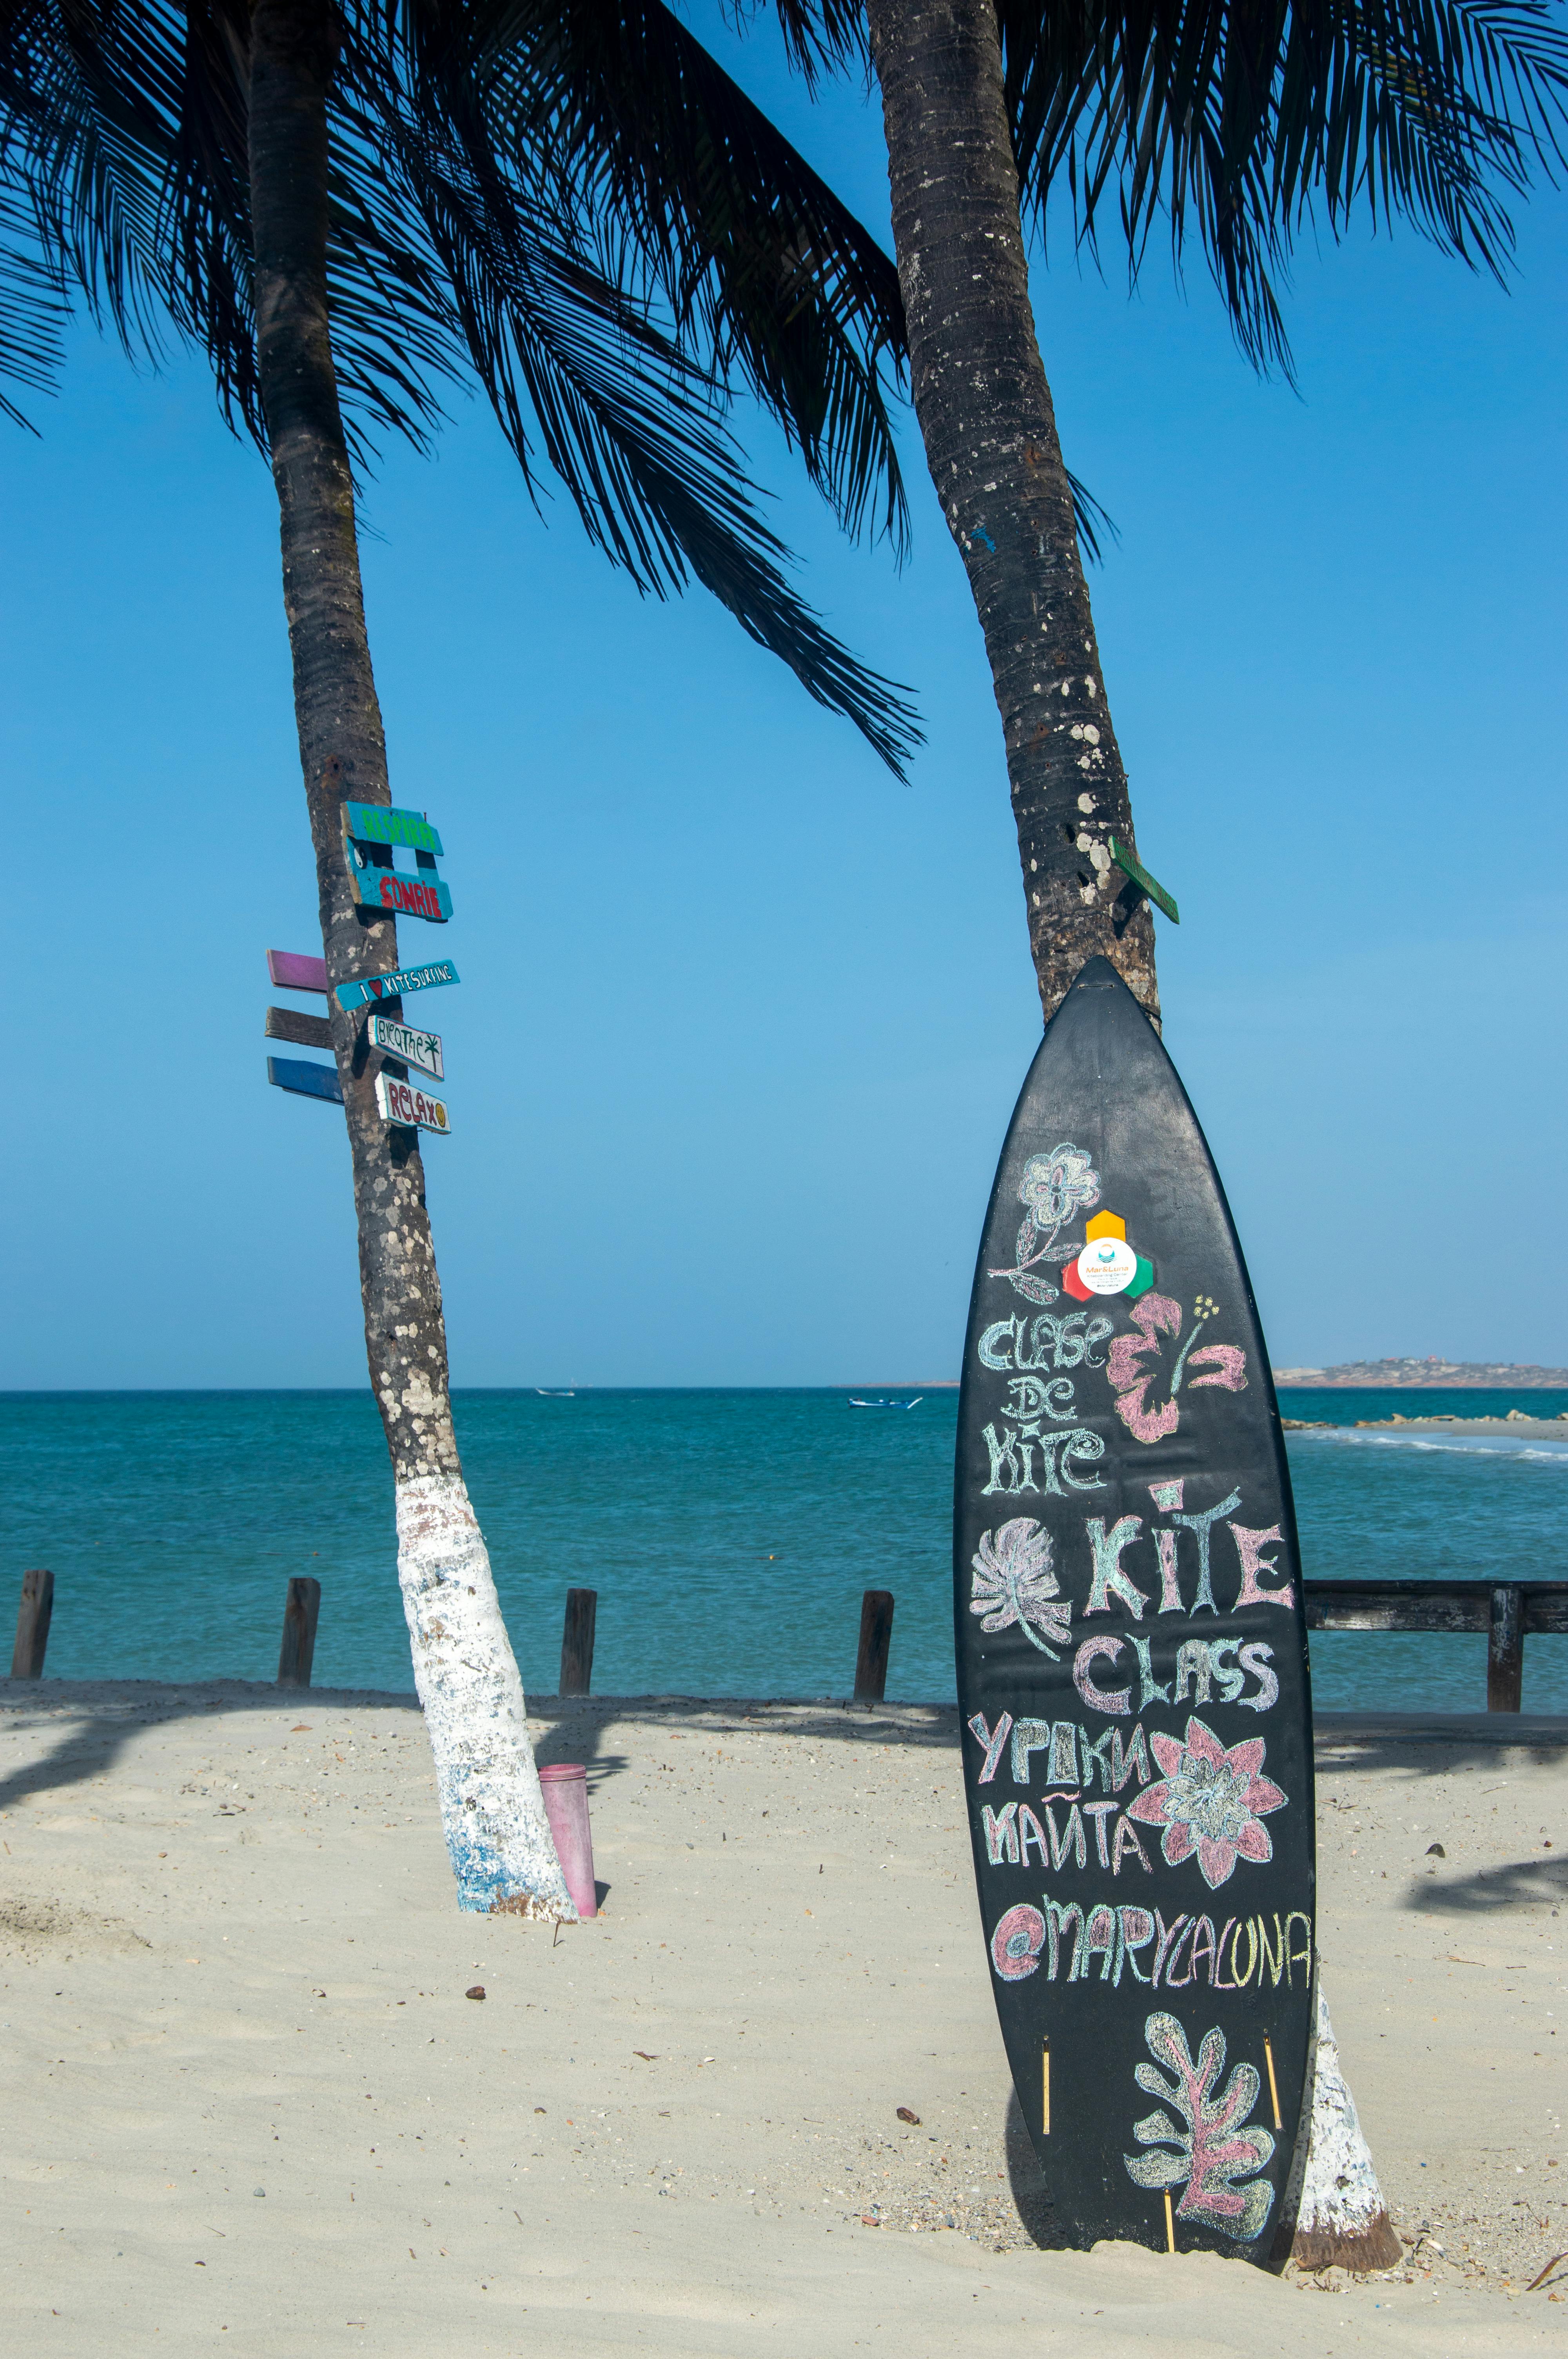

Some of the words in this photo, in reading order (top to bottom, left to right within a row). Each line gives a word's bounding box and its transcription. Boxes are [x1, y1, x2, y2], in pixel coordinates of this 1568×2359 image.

[359, 983, 368, 1001] I
[1073, 1633, 1279, 1715] CLASS
[981, 1791, 1153, 1875] КАЙТА
